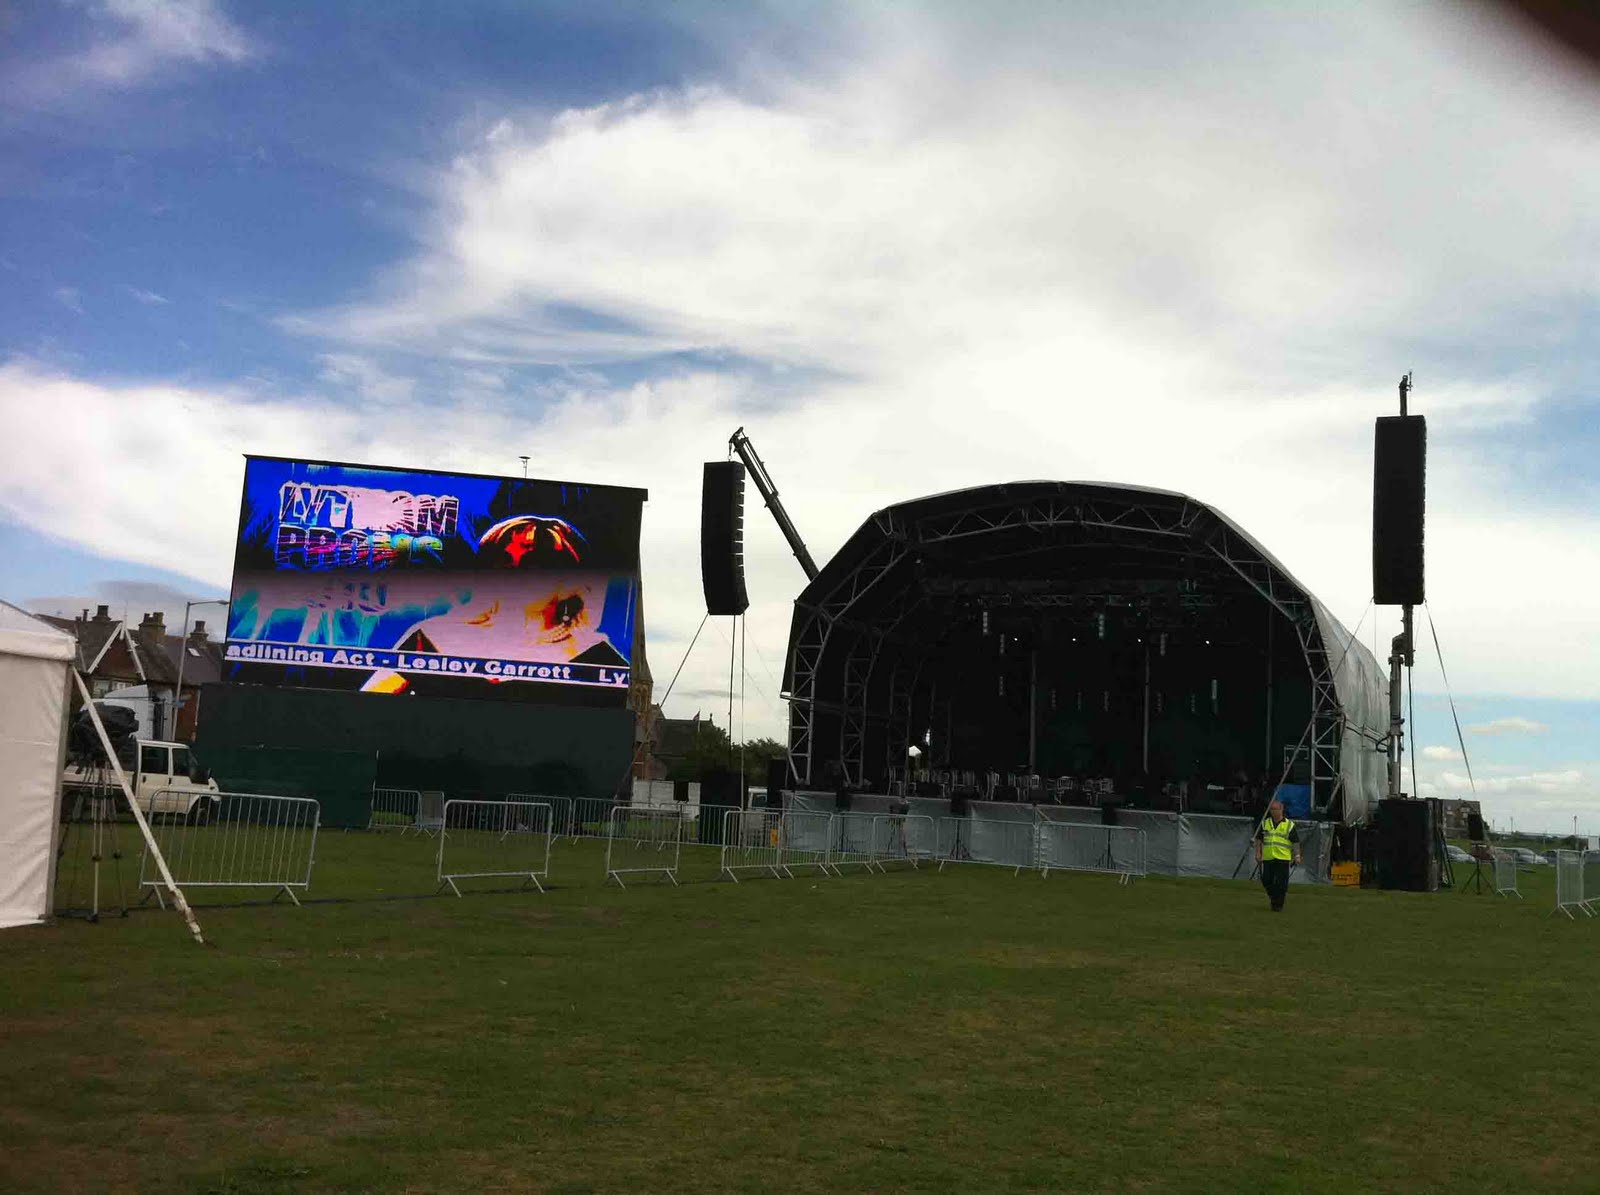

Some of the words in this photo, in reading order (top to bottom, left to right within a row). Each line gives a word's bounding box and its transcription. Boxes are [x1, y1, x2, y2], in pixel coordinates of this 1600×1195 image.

[332, 650, 376, 665] Act
[398, 654, 476, 674] Lesley
[484, 660, 571, 679] Garrett
[599, 668, 629, 686] Ly
